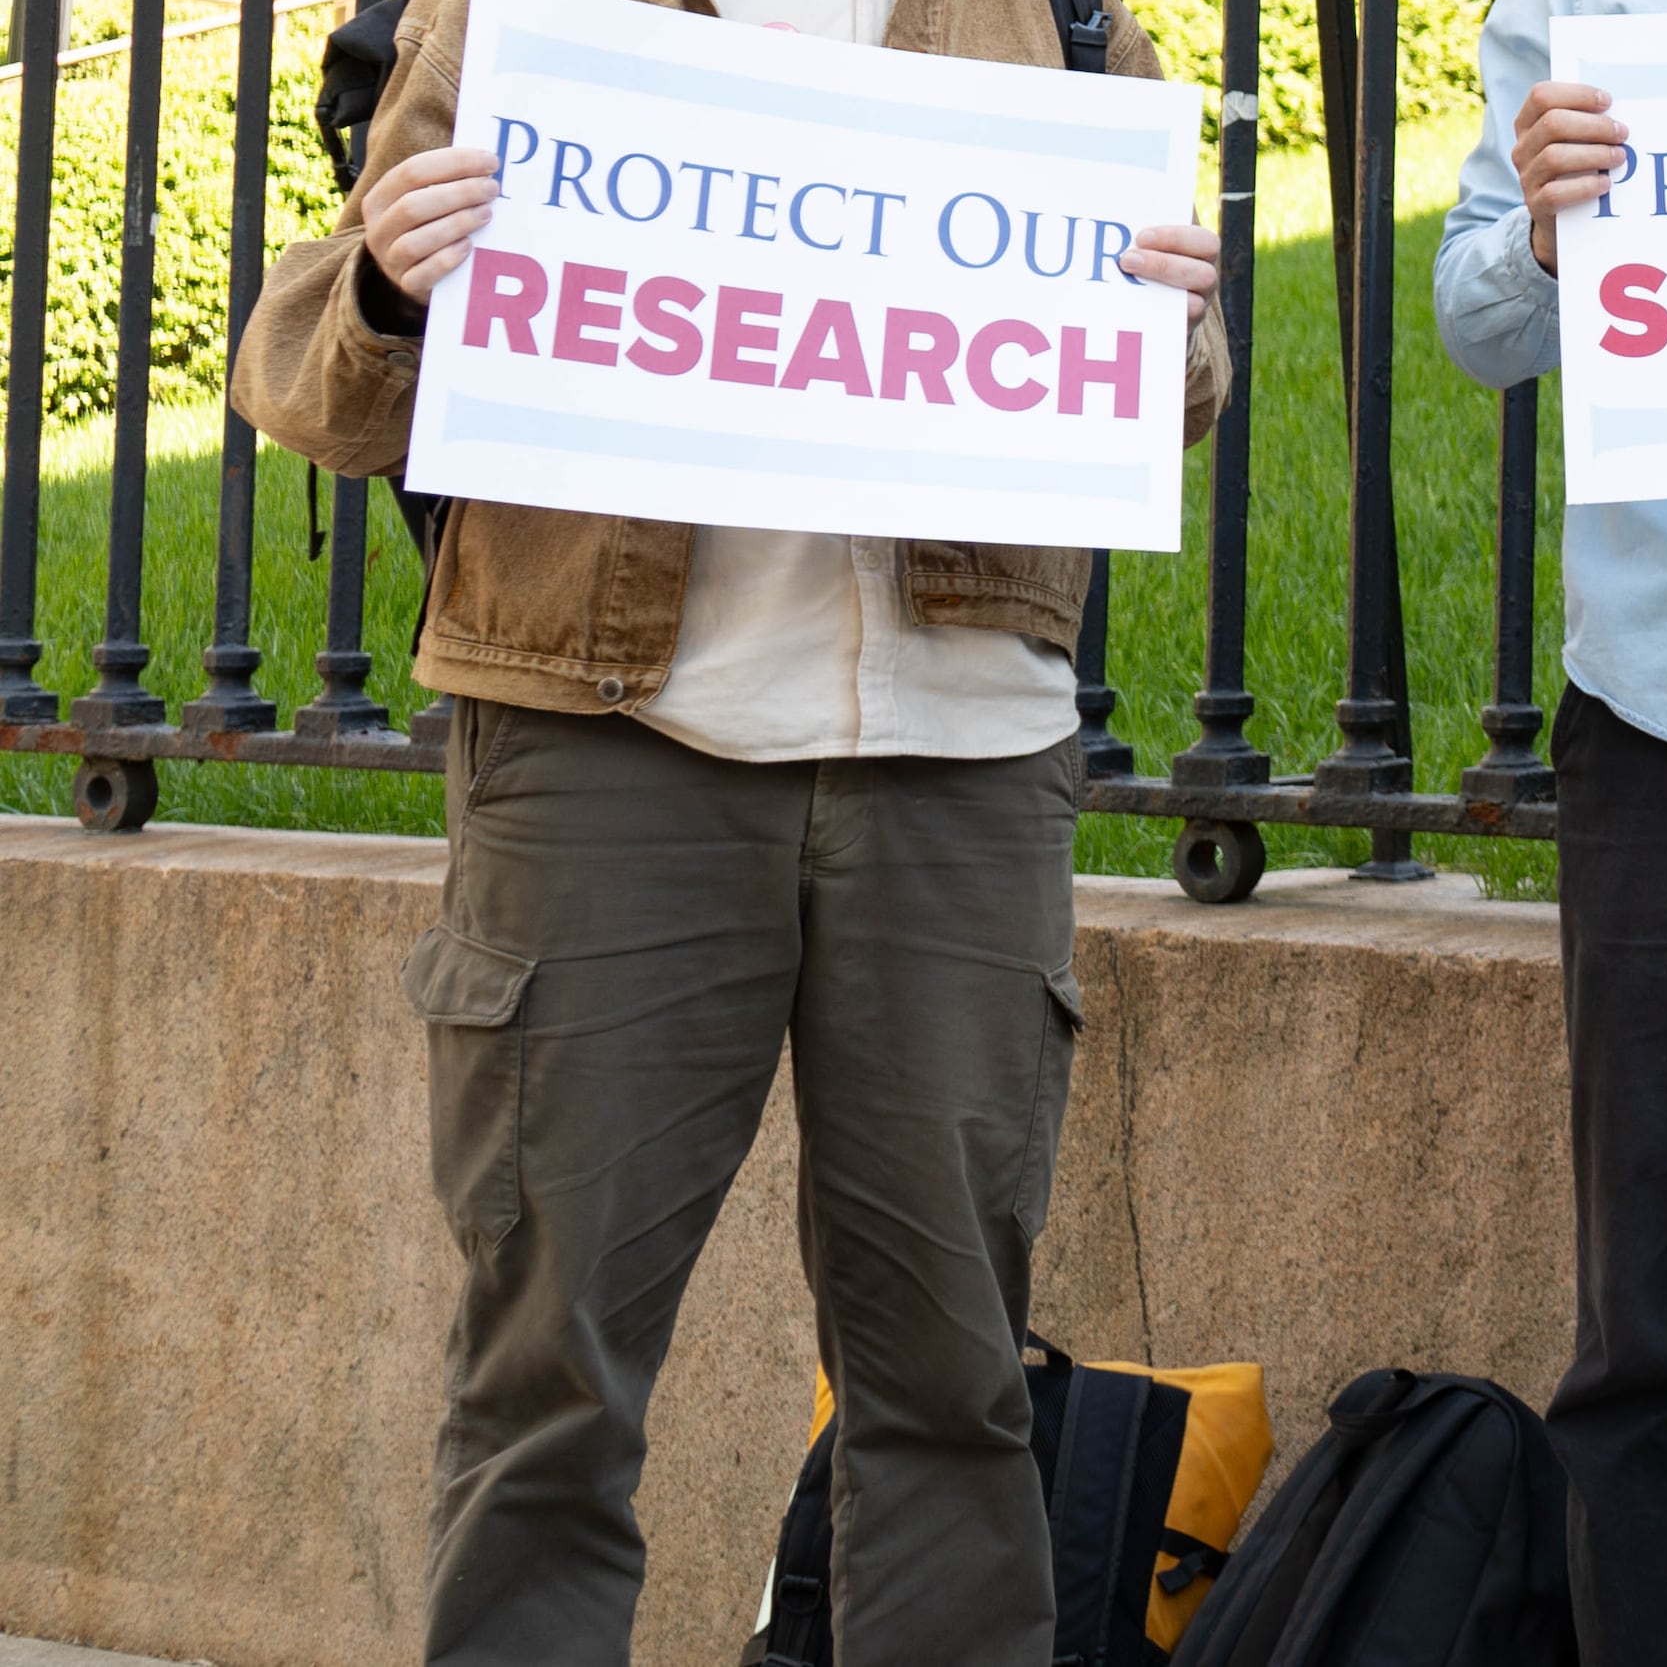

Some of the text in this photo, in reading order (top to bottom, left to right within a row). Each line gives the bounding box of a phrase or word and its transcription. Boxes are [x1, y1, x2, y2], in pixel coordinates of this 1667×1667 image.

[490, 115, 1147, 286] PROTECT OUR
[462, 248, 1142, 420] RESEARCH
